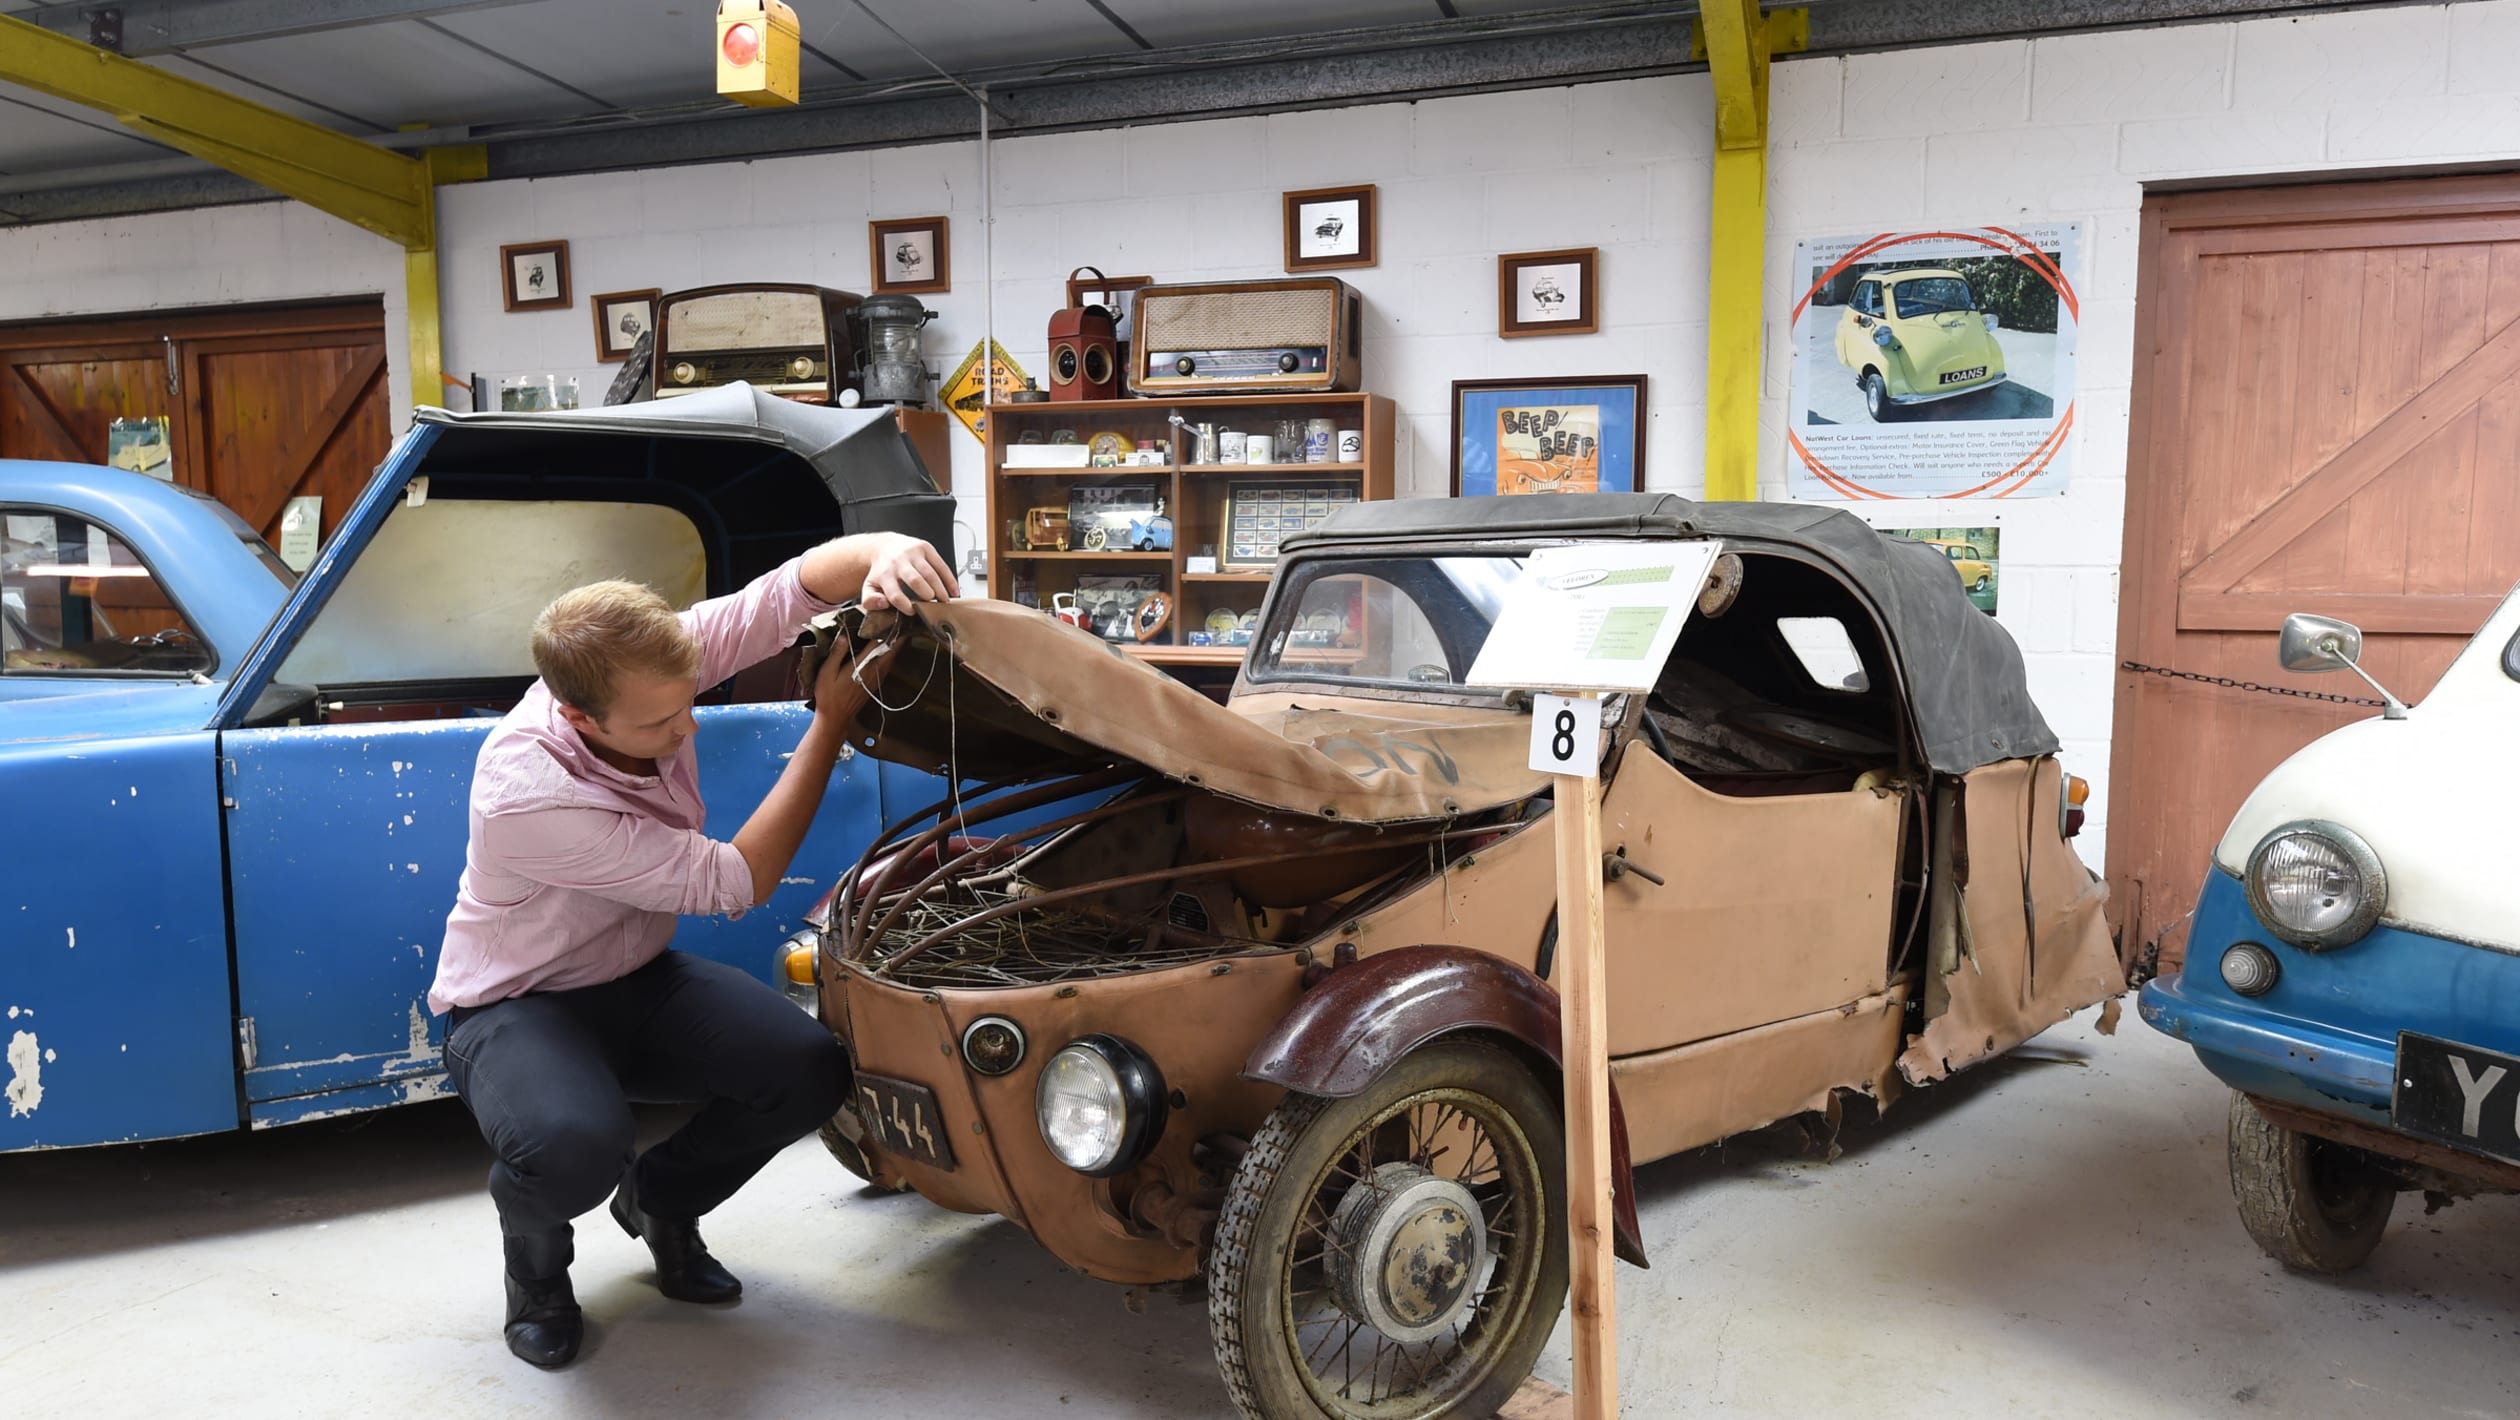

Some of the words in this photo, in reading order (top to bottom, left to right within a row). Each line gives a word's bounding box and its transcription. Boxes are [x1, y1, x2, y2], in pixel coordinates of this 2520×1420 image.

[2050, 239, 2060, 247] 06
[1945, 367, 1984, 383] LOANS
[1502, 410, 1568, 438] BEEP!
[1539, 431, 1598, 466] BEEP!
[1552, 710, 1576, 761] 8
[2447, 1054, 2520, 1140] Y
[852, 1086, 936, 1158] 744
